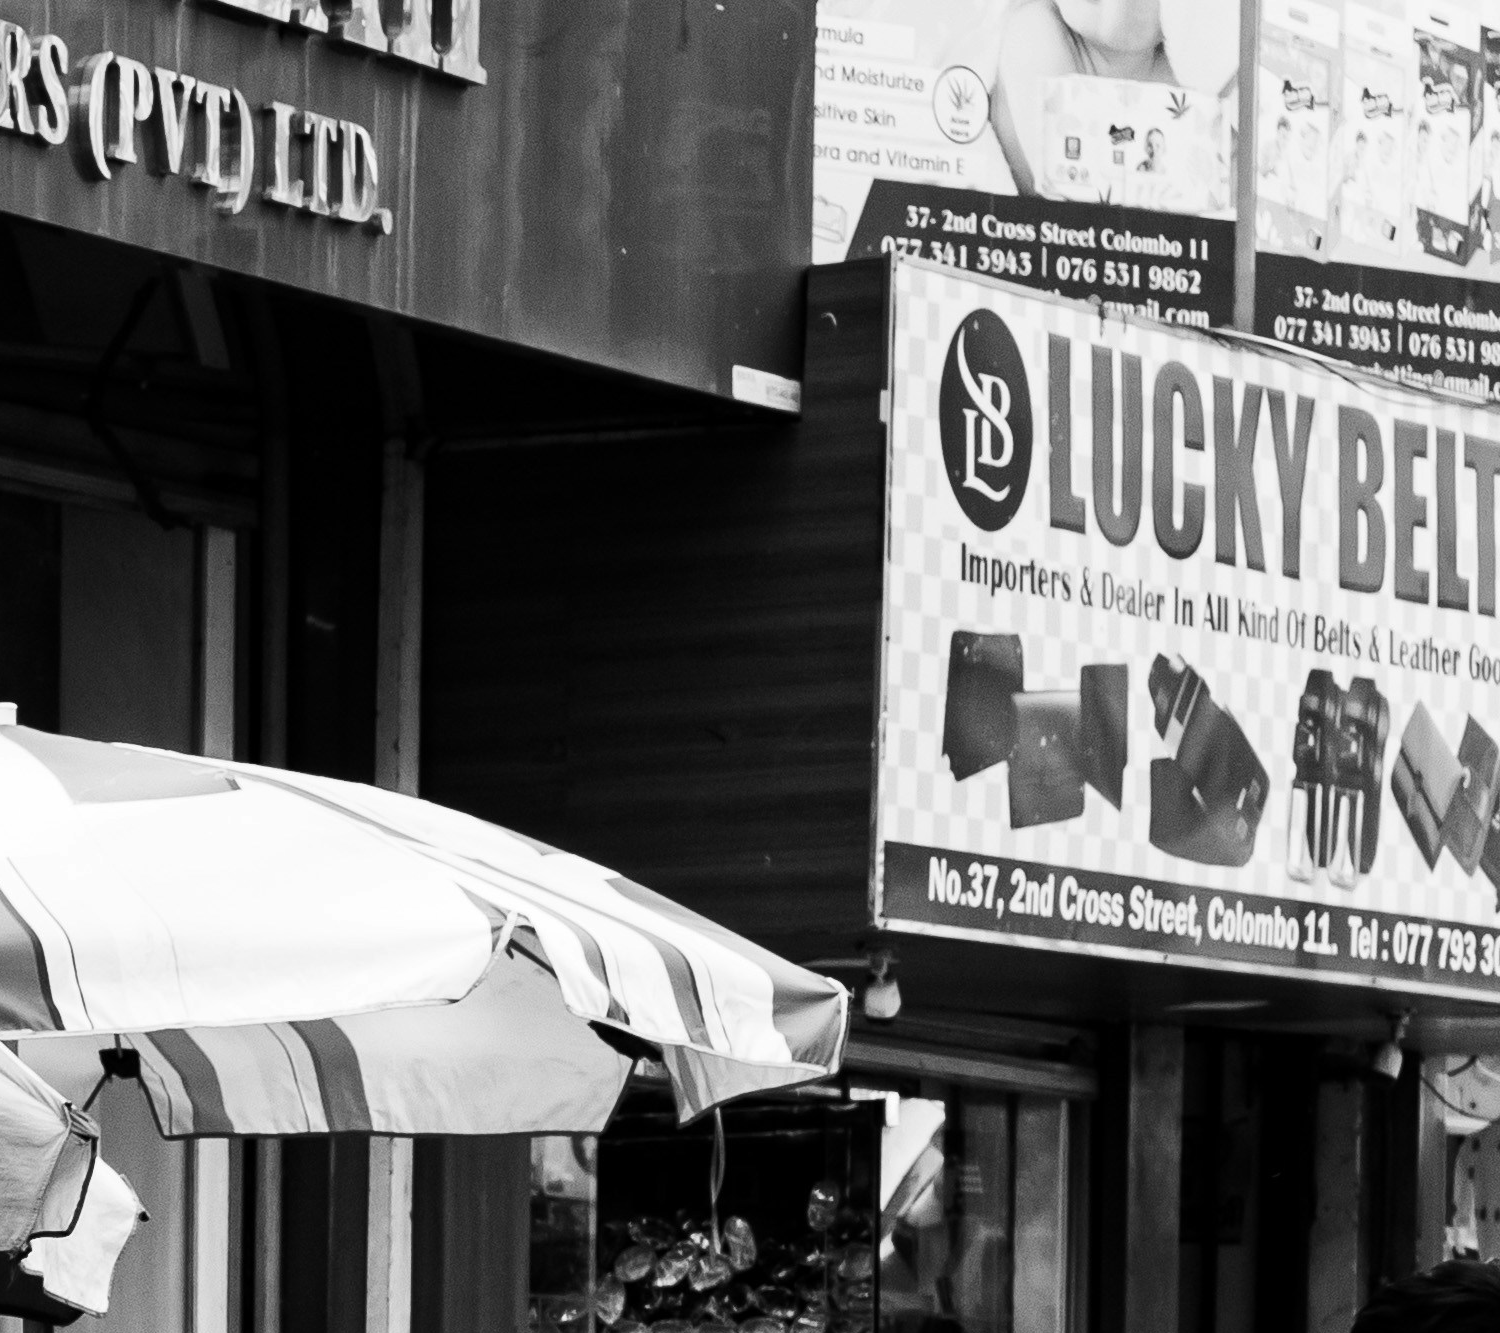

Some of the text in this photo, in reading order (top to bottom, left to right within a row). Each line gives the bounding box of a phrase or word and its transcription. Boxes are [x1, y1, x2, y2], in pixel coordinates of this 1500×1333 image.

[842, 66, 925, 93] Moisturize
[80, 50, 253, 215] (PVT)
[264, 101, 392, 235] LTD.
[864, 110, 896, 128] Skin
[847, 148, 880, 165] and
[886, 150, 952, 174] Vitamin
[943, 210, 977, 235] 2nd
[982, 214, 1036, 242] Cross
[1041, 222, 1096, 248] Street
[1101, 228, 1182, 258] Colombo
[1190, 240, 1209, 260] 11
[977, 247, 1032, 277] 3943
[1056, 256, 1097, 283] 076
[1149, 267, 1202, 295] 9862
[1322, 289, 1350, 315] 2nd
[1354, 293, 1393, 319] Cross
[1396, 299, 1441, 326] Street
[1274, 315, 1308, 342] 077
[1312, 319, 1342, 347] 341
[1349, 324, 1391, 352] 3943
[1408, 331, 1441, 360] 076
[1048, 332, 1315, 580] LUCKY
[961, 543, 1071, 602] Importers
[1080, 567, 1094, 607] &
[1102, 572, 1165, 624] Dealer
[1174, 587, 1194, 627] In
[1204, 593, 1228, 633] All
[1238, 600, 1278, 645] Kind
[1287, 609, 1307, 649] Of
[1314, 615, 1362, 660] Belts
[1370, 626, 1381, 662] &
[1389, 630, 1460, 676] Leather
[928, 857, 1004, 918] No.37,
[1010, 869, 1054, 917] 2nd
[1060, 876, 1124, 929] Cross
[1128, 886, 1201, 946] Street,
[1207, 897, 1299, 951] Colombo
[1304, 911, 1338, 955] 11.
[1393, 922, 1432, 967] 077
[1438, 928, 1477, 975] 793
